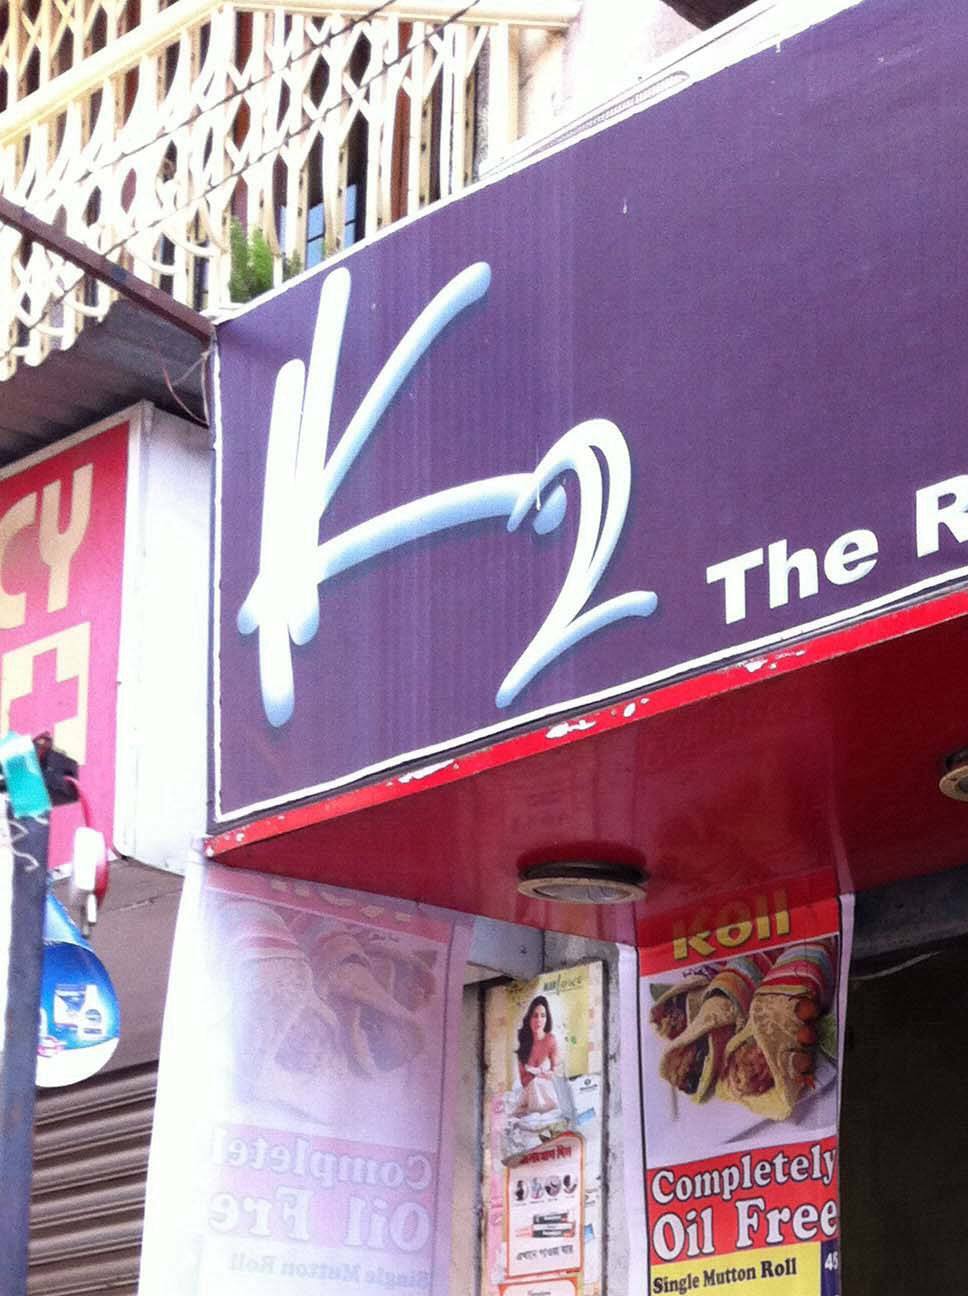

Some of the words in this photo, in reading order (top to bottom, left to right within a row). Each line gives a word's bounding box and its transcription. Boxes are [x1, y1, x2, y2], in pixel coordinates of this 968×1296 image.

[705, 527, 879, 626] The
[651, 1143, 838, 1204] Completely
[652, 1207, 715, 1262] Oil
[735, 1197, 839, 1250] Free
[652, 1270, 700, 1296] Single
[702, 1260, 757, 1287] Mutton
[760, 1257, 797, 1278] Roll
